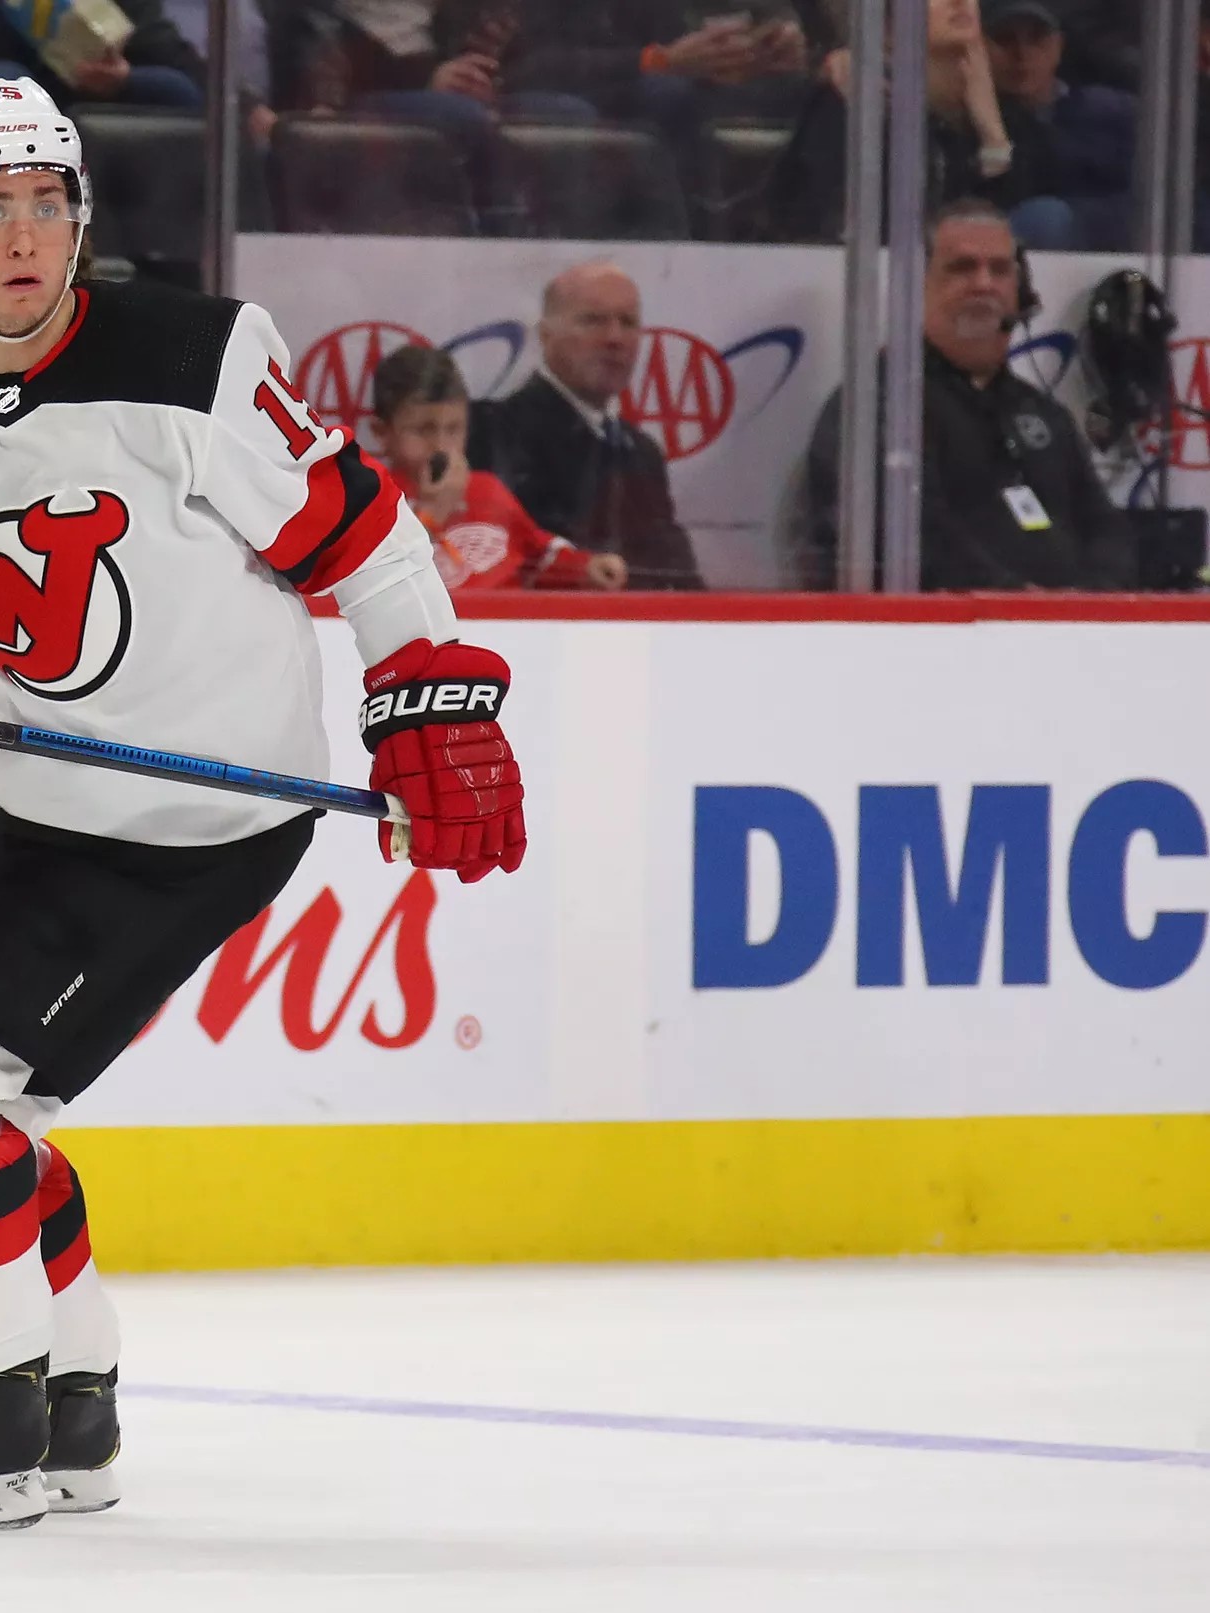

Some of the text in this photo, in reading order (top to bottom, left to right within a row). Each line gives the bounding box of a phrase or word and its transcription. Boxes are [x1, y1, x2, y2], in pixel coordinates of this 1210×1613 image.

[619, 327, 731, 461] AA
[692, 778, 1210, 991] DMC
[40, 972, 85, 1026] BAUER
